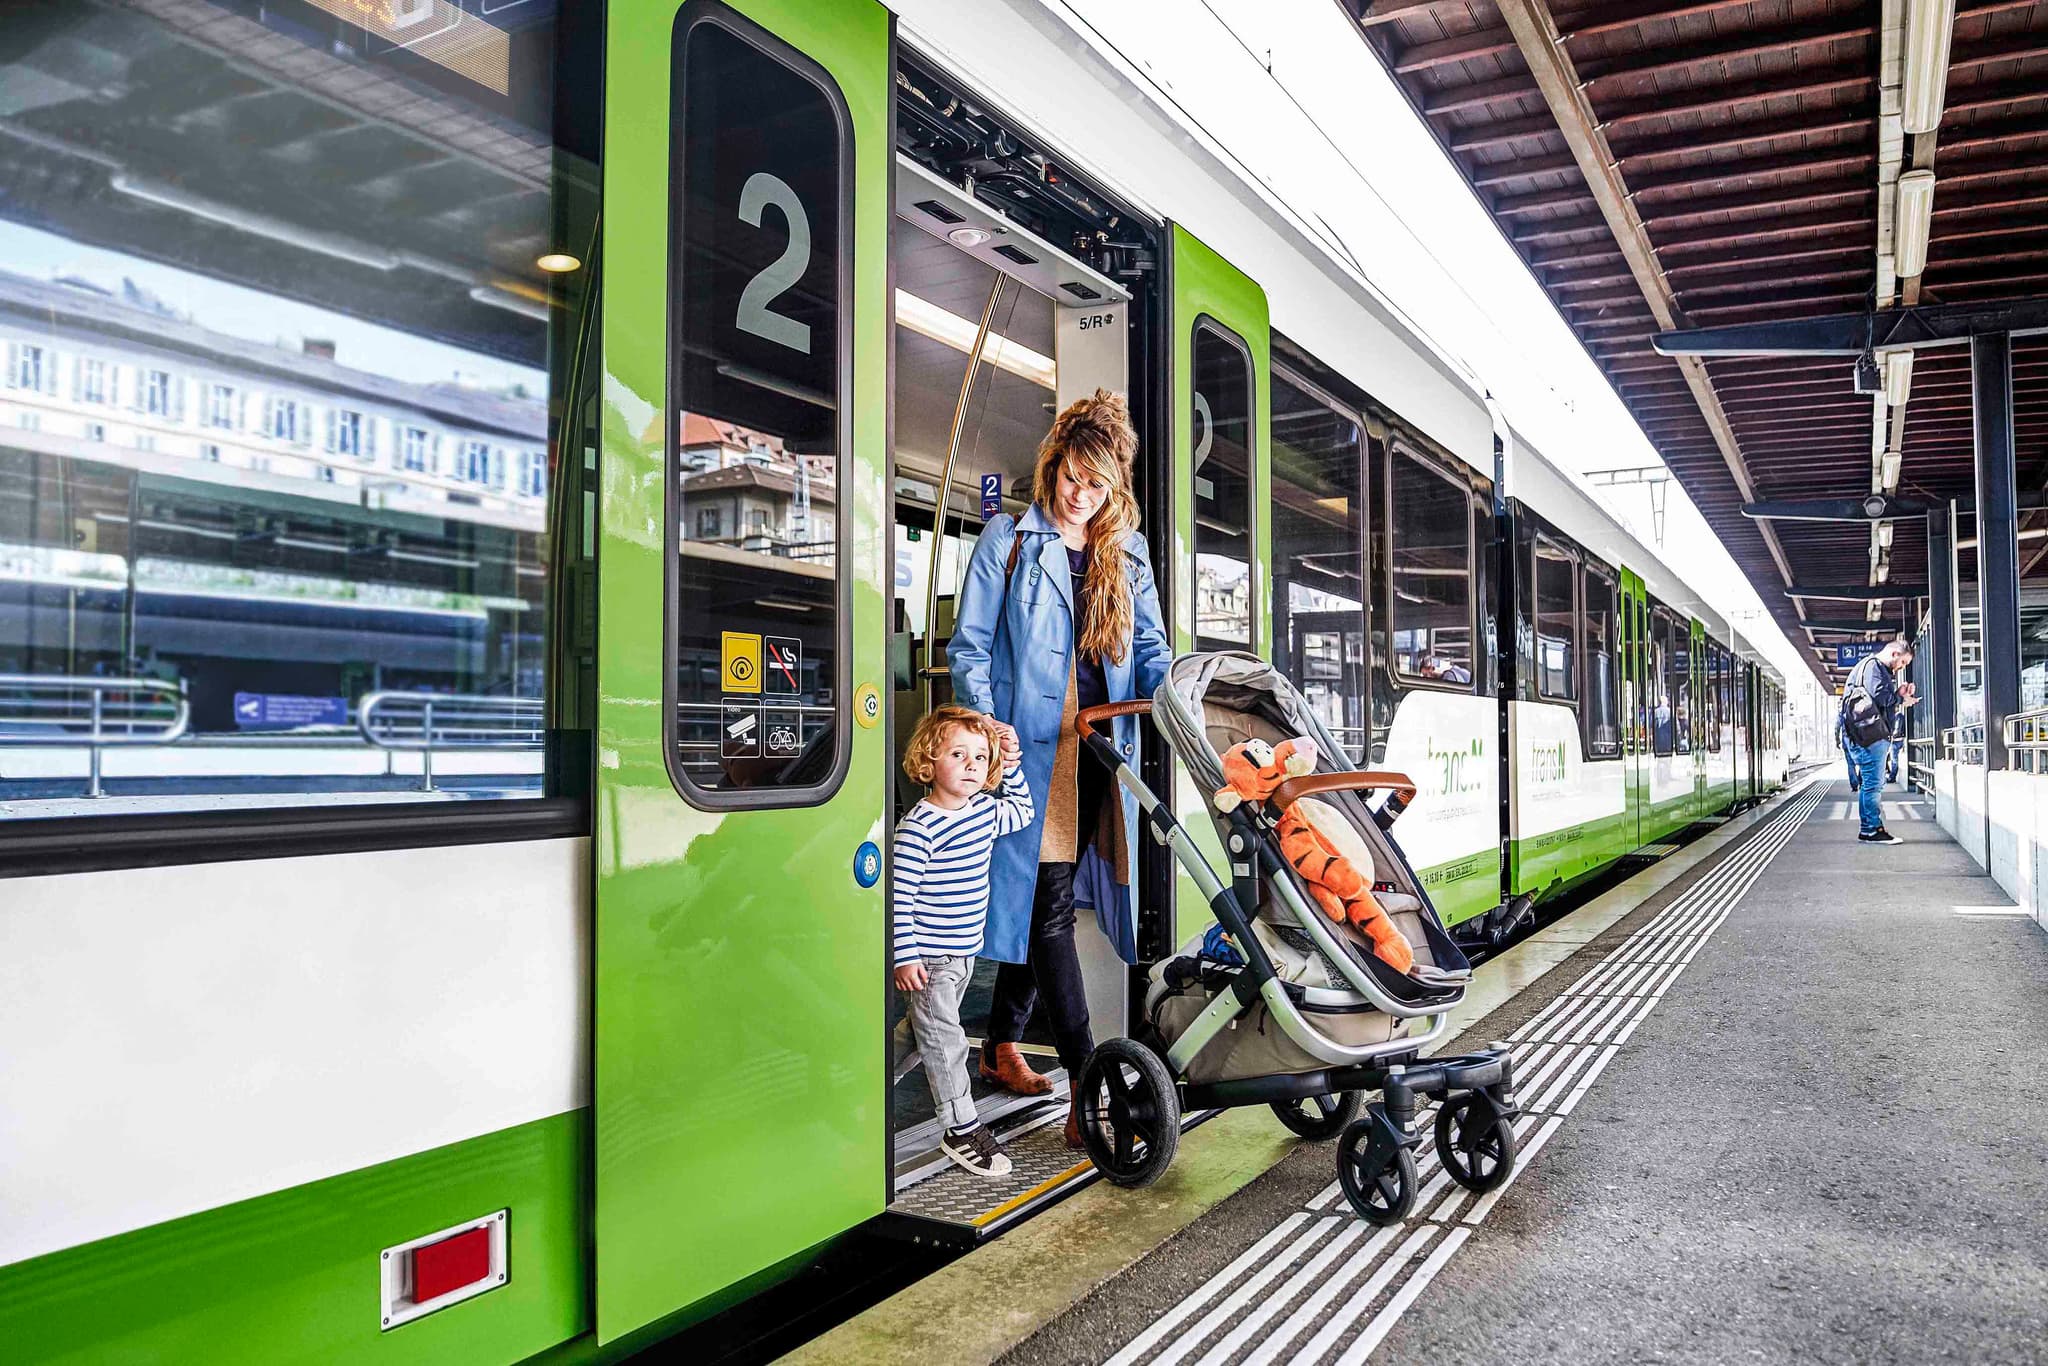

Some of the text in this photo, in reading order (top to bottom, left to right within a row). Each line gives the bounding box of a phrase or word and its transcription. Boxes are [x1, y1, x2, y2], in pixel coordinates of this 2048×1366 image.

[736, 172, 811, 355] 2
[1079, 314, 1103, 330] 5/R
[985, 475, 998, 497] 2
[1616, 612, 1622, 653] 2
[1647, 629, 1653, 665] 2
[1530, 735, 1567, 783] transN
